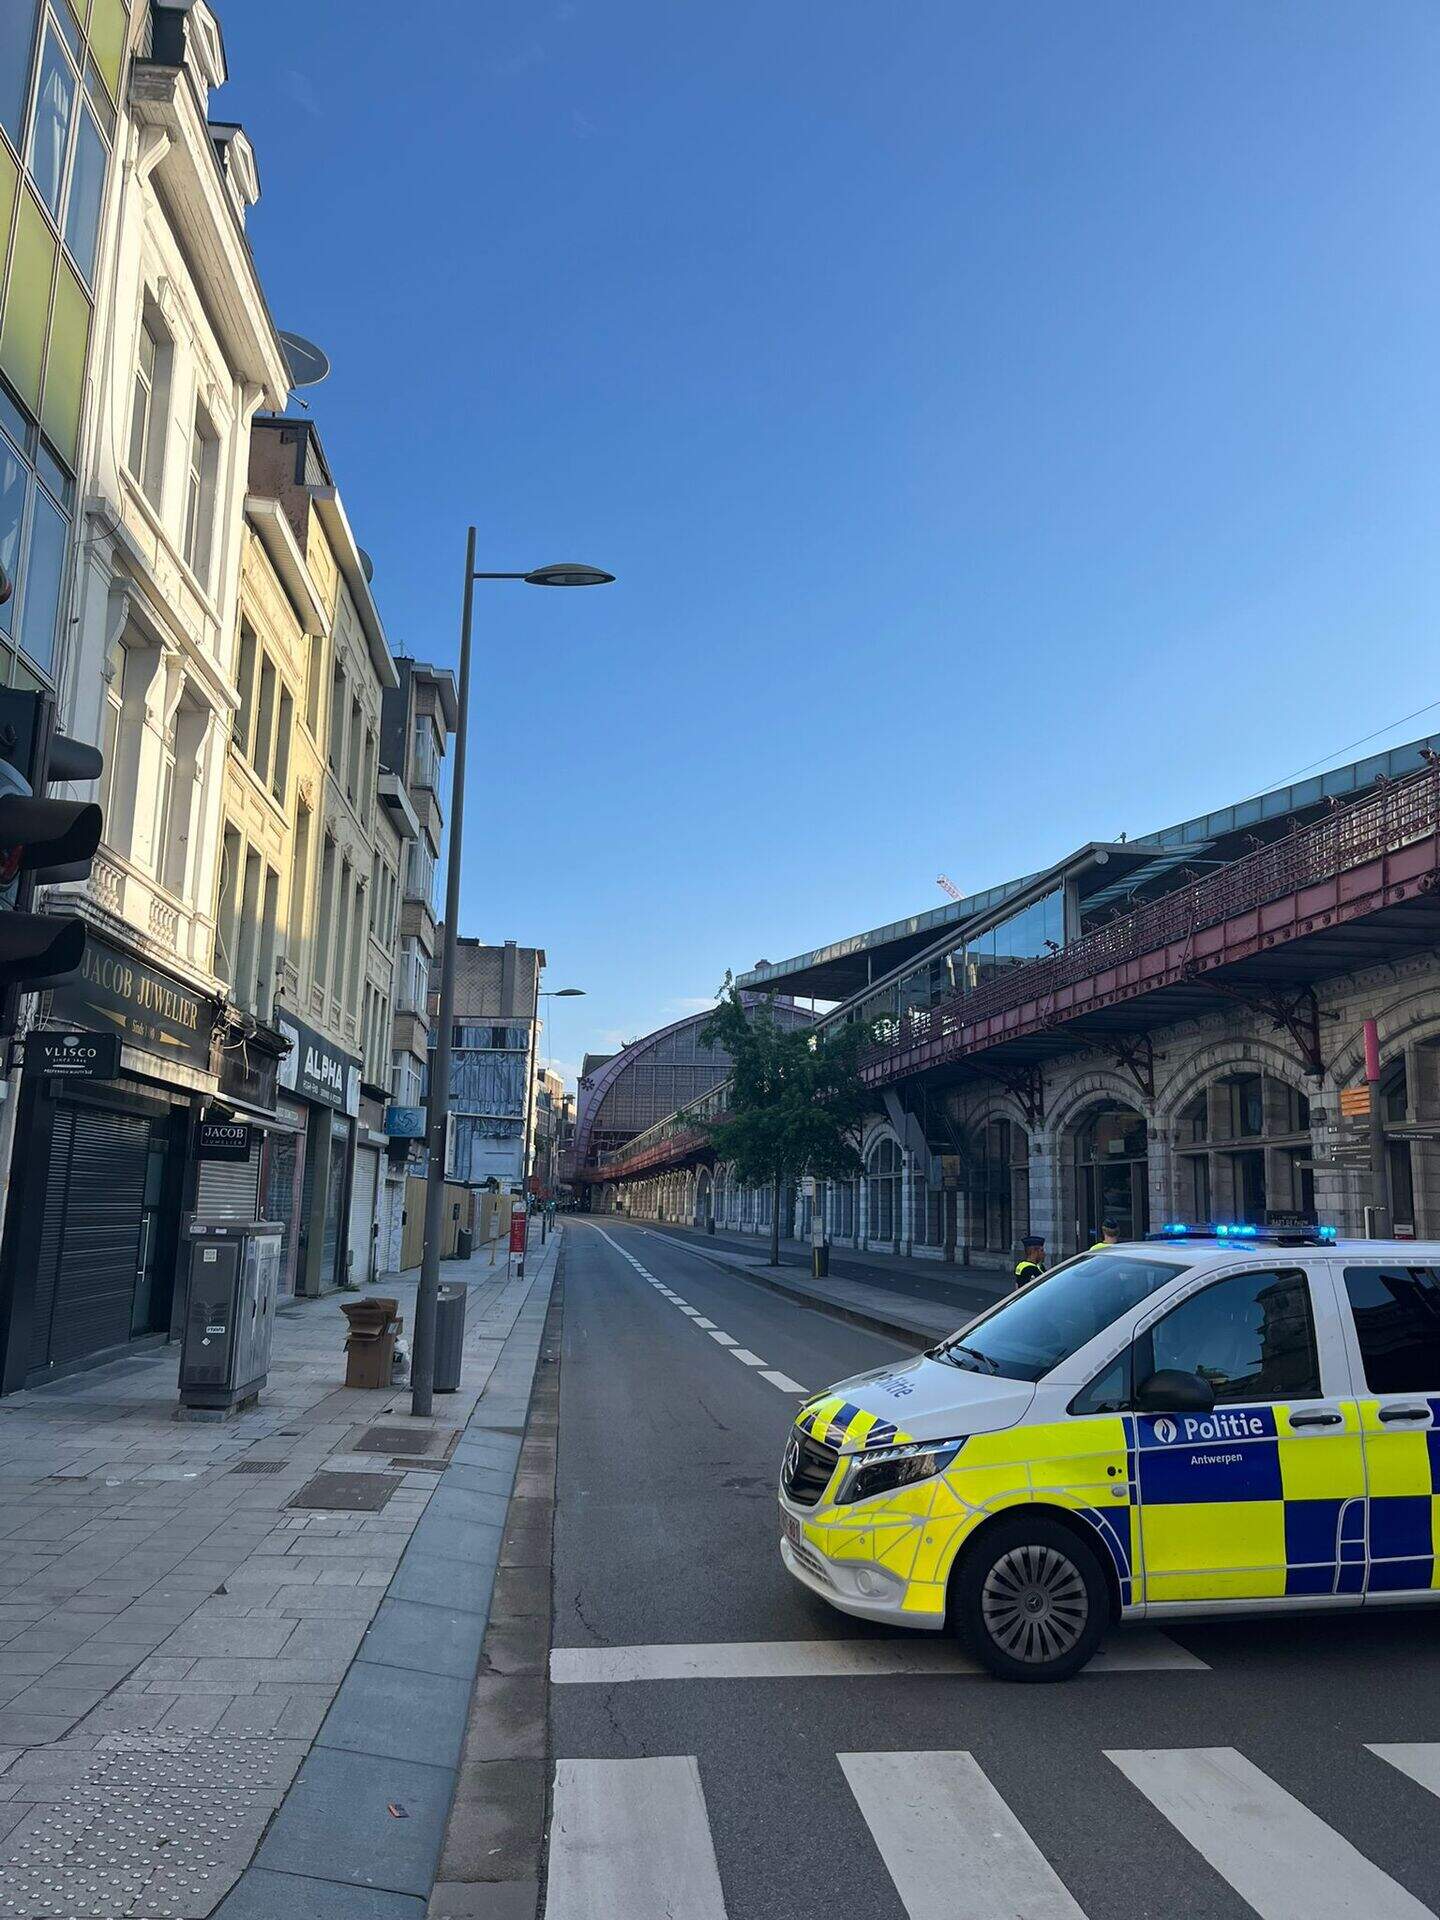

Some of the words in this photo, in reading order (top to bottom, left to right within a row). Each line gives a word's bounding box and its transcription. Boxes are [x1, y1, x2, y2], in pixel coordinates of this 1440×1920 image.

[82, 947, 133, 998] JACOB
[137, 976, 198, 1030] JUWELIER
[45, 1047, 97, 1058] VLISCO
[304, 1046, 343, 1092] ALPHA
[205, 1127, 244, 1138] JACOB
[1184, 1413, 1264, 1440] Politie
[1191, 1453, 1243, 1465] Antwerpen
